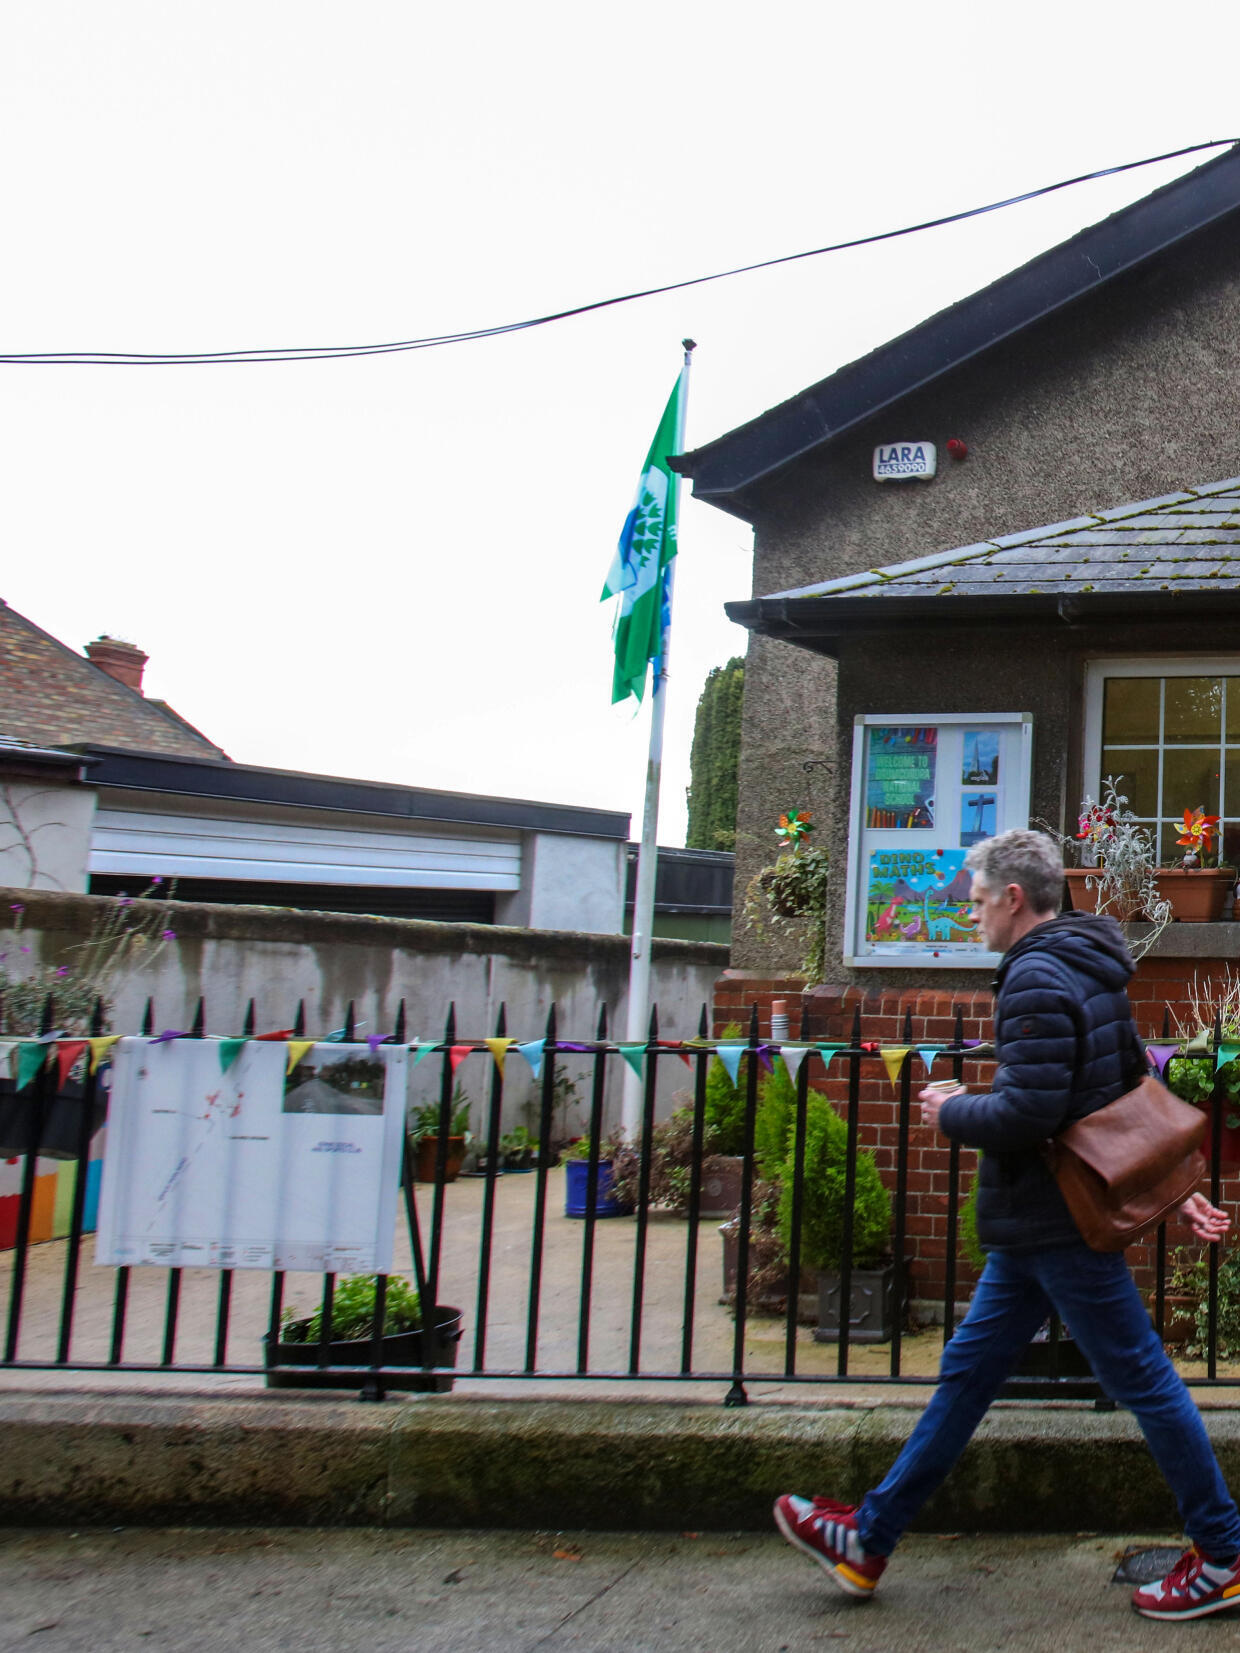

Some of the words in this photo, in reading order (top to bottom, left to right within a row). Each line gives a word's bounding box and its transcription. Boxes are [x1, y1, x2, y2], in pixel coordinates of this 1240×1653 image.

[879, 446, 926, 463] LARA
[880, 852, 925, 865] DINO
[872, 862, 937, 879] MATHS
